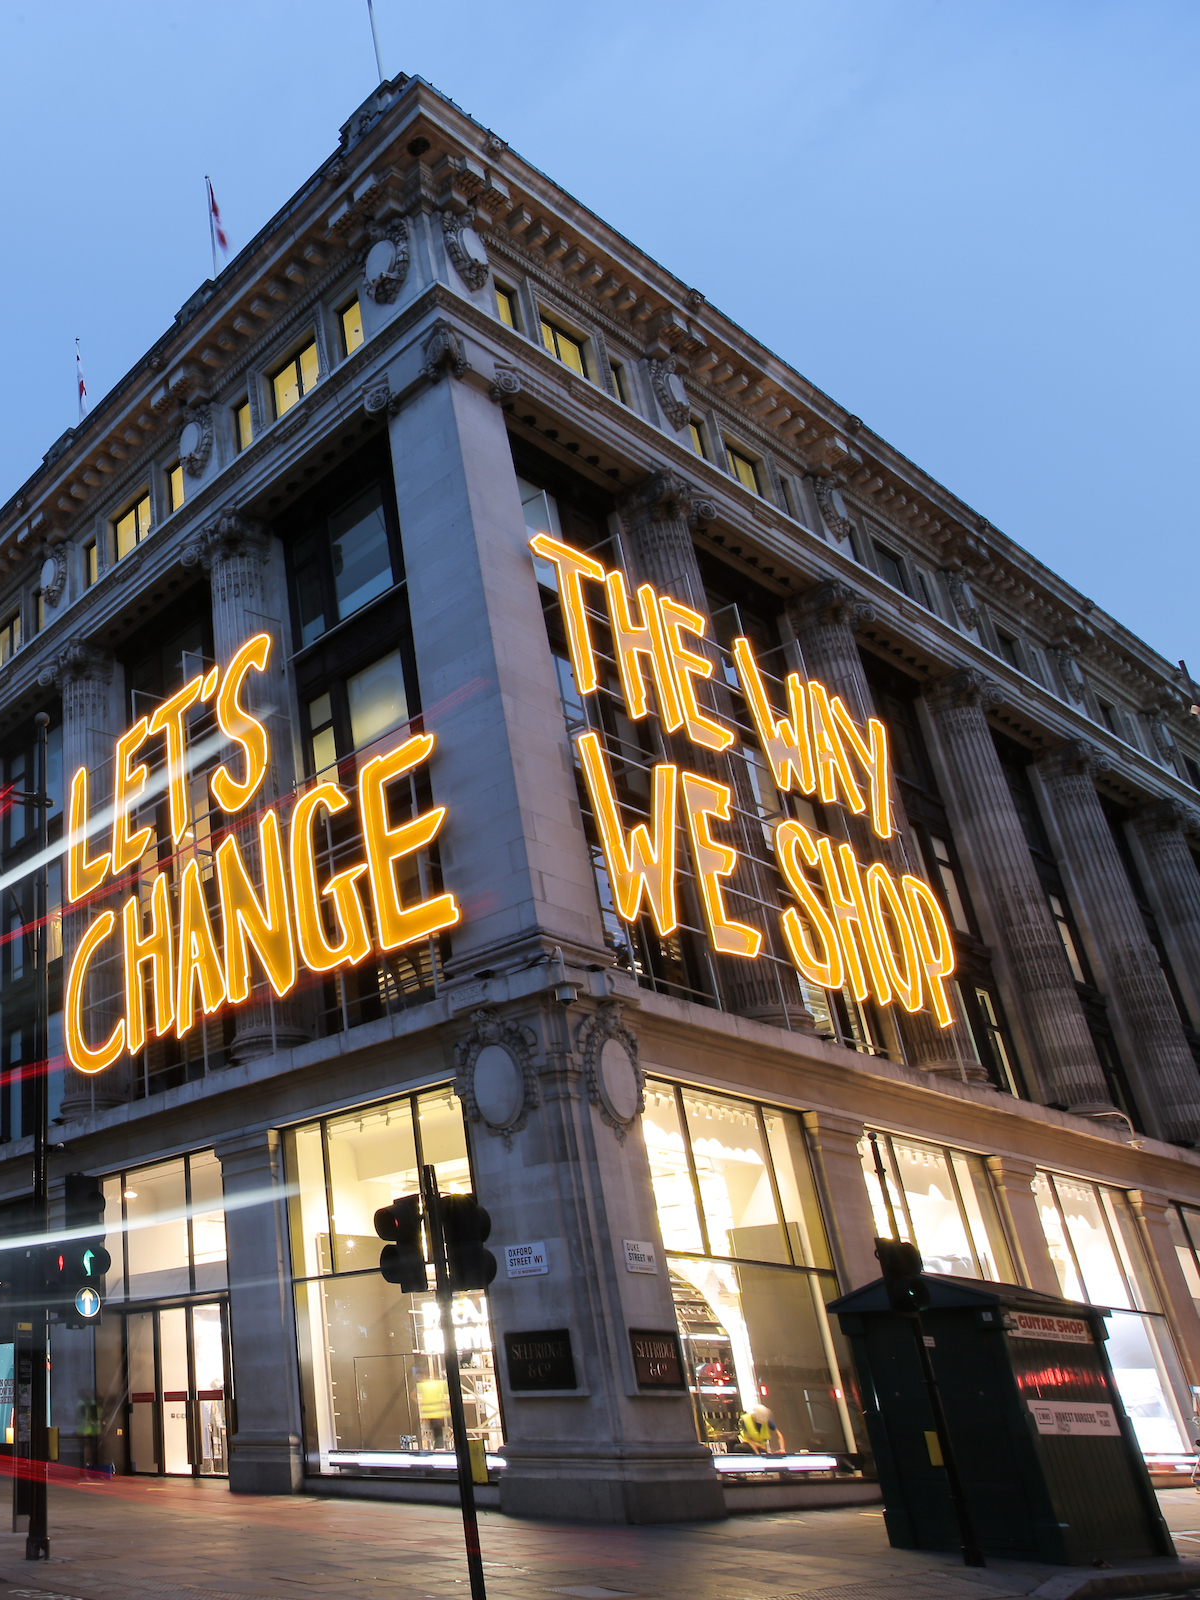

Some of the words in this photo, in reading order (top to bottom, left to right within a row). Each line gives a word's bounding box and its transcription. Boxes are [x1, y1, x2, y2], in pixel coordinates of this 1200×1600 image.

[529, 533, 734, 752] THE
[732, 637, 892, 839] WAY
[67, 633, 271, 904] LET'S
[576, 732, 762, 959] WE
[775, 819, 956, 1028] SHOP
[65, 733, 460, 1074] CHANGE
[508, 1246, 533, 1258] OXFORD
[626, 1242, 640, 1253] DUKE
[628, 1252, 646, 1263] STREET
[647, 1254, 655, 1263] W1
[509, 1256, 532, 1267] STREET
[534, 1254, 544, 1264] W1
[1017, 1314, 1057, 1332] GUITAR
[1056, 1319, 1085, 1335] SHOP
[511, 1340, 567, 1361] SELFRIDGE
[634, 1340, 677, 1359] SELFRIDGE
[1054, 1411, 1075, 1423] HONEST
[1074, 1412, 1097, 1424] BURGERS
